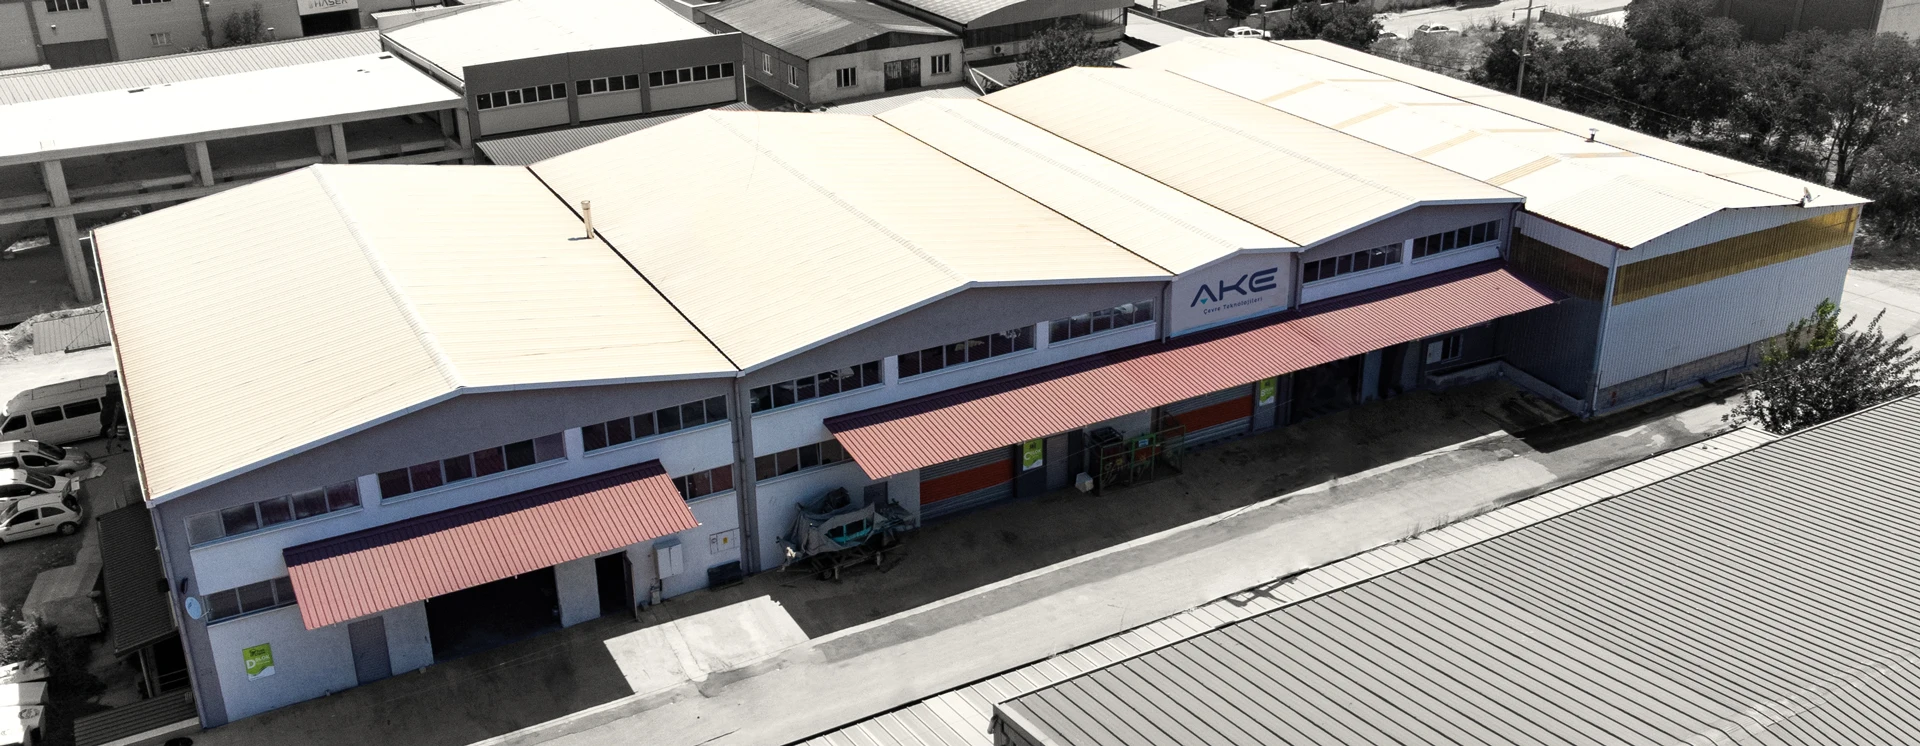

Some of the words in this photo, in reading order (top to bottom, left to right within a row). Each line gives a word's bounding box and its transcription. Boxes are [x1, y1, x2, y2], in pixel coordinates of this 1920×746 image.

[1190, 267, 1278, 308] AKE
[1203, 306, 1221, 315] Çevre
[1223, 297, 1263, 310] Teknolojileri
